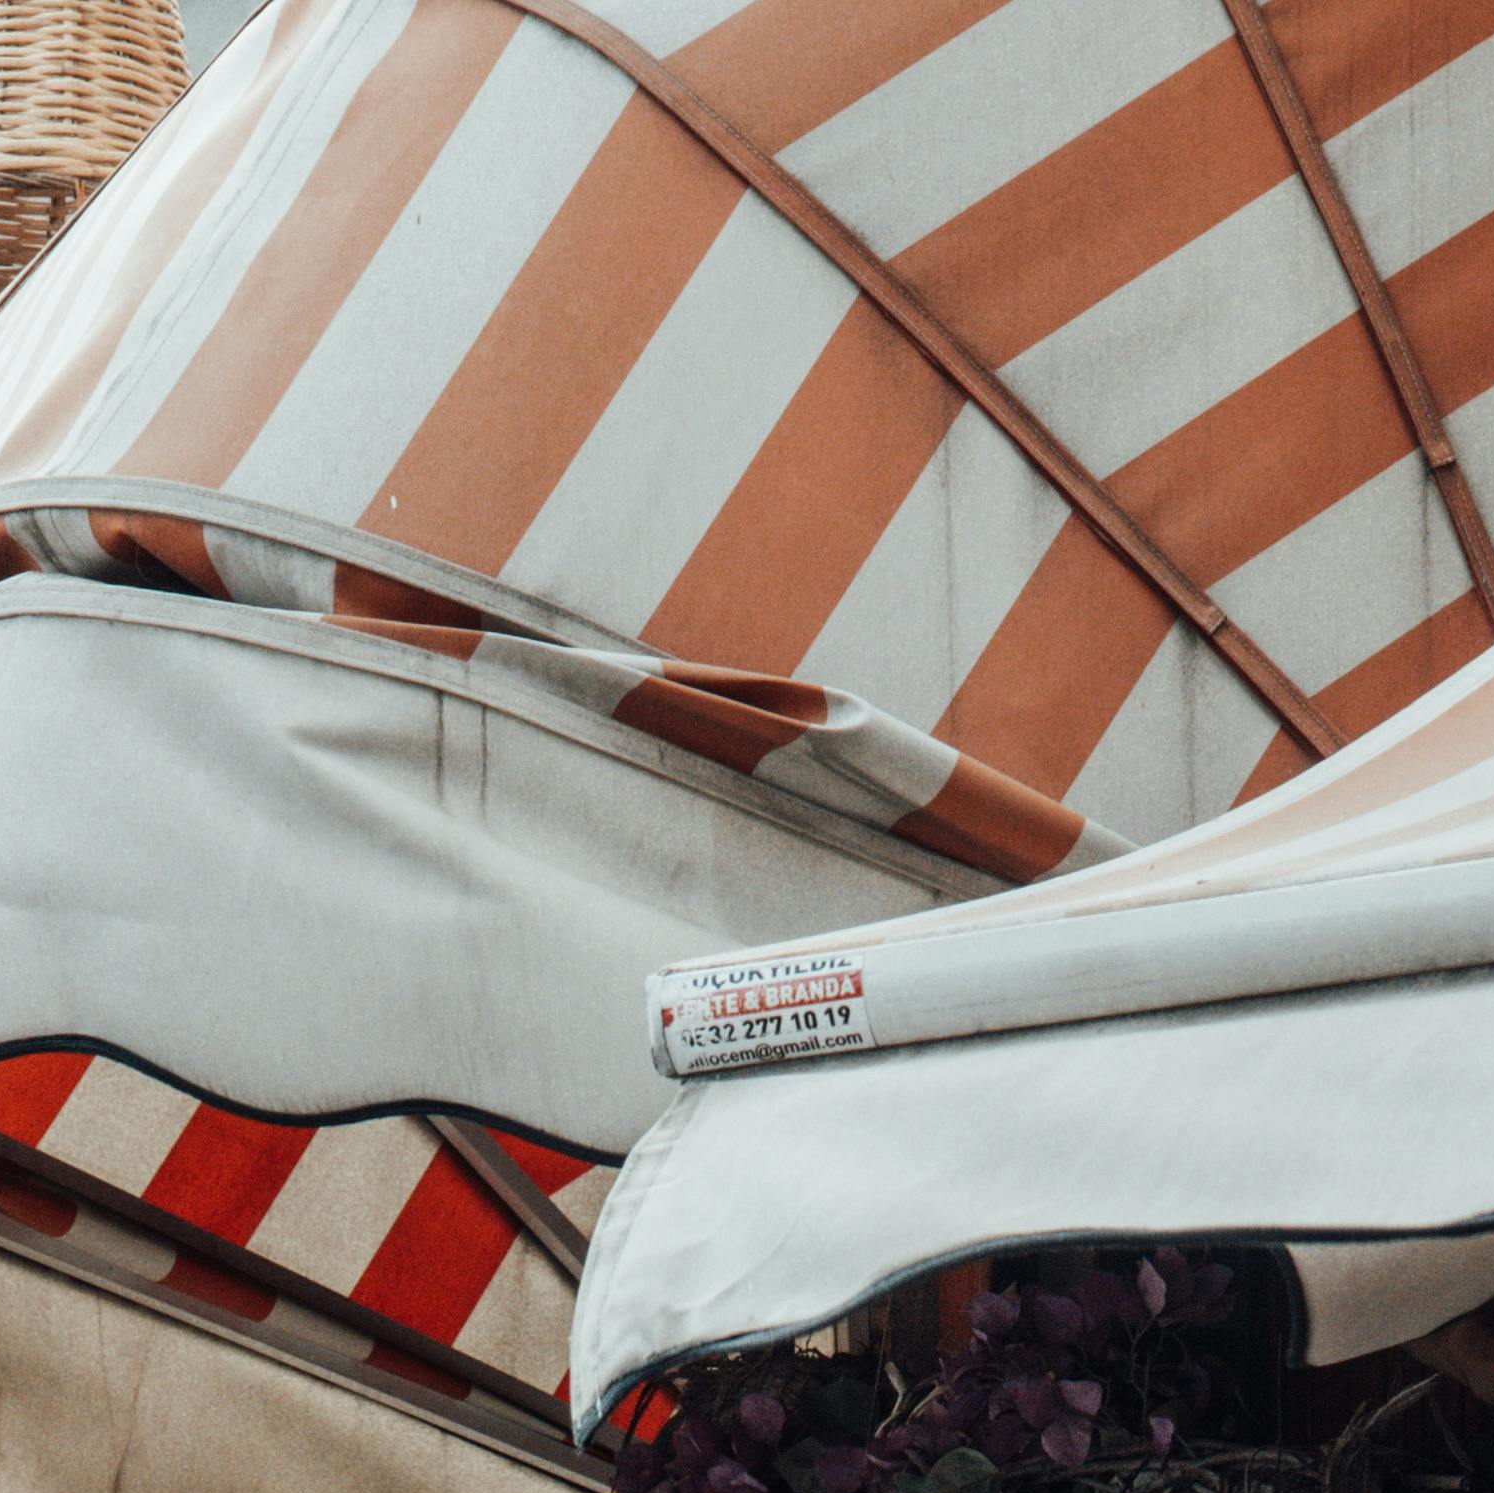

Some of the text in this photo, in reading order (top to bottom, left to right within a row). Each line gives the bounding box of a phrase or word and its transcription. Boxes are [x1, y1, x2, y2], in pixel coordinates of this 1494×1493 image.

[766, 974, 855, 1007] BRANDA
[743, 1014, 783, 1040] 277
[791, 1010, 818, 1032] 10
[824, 1005, 850, 1027] 19
